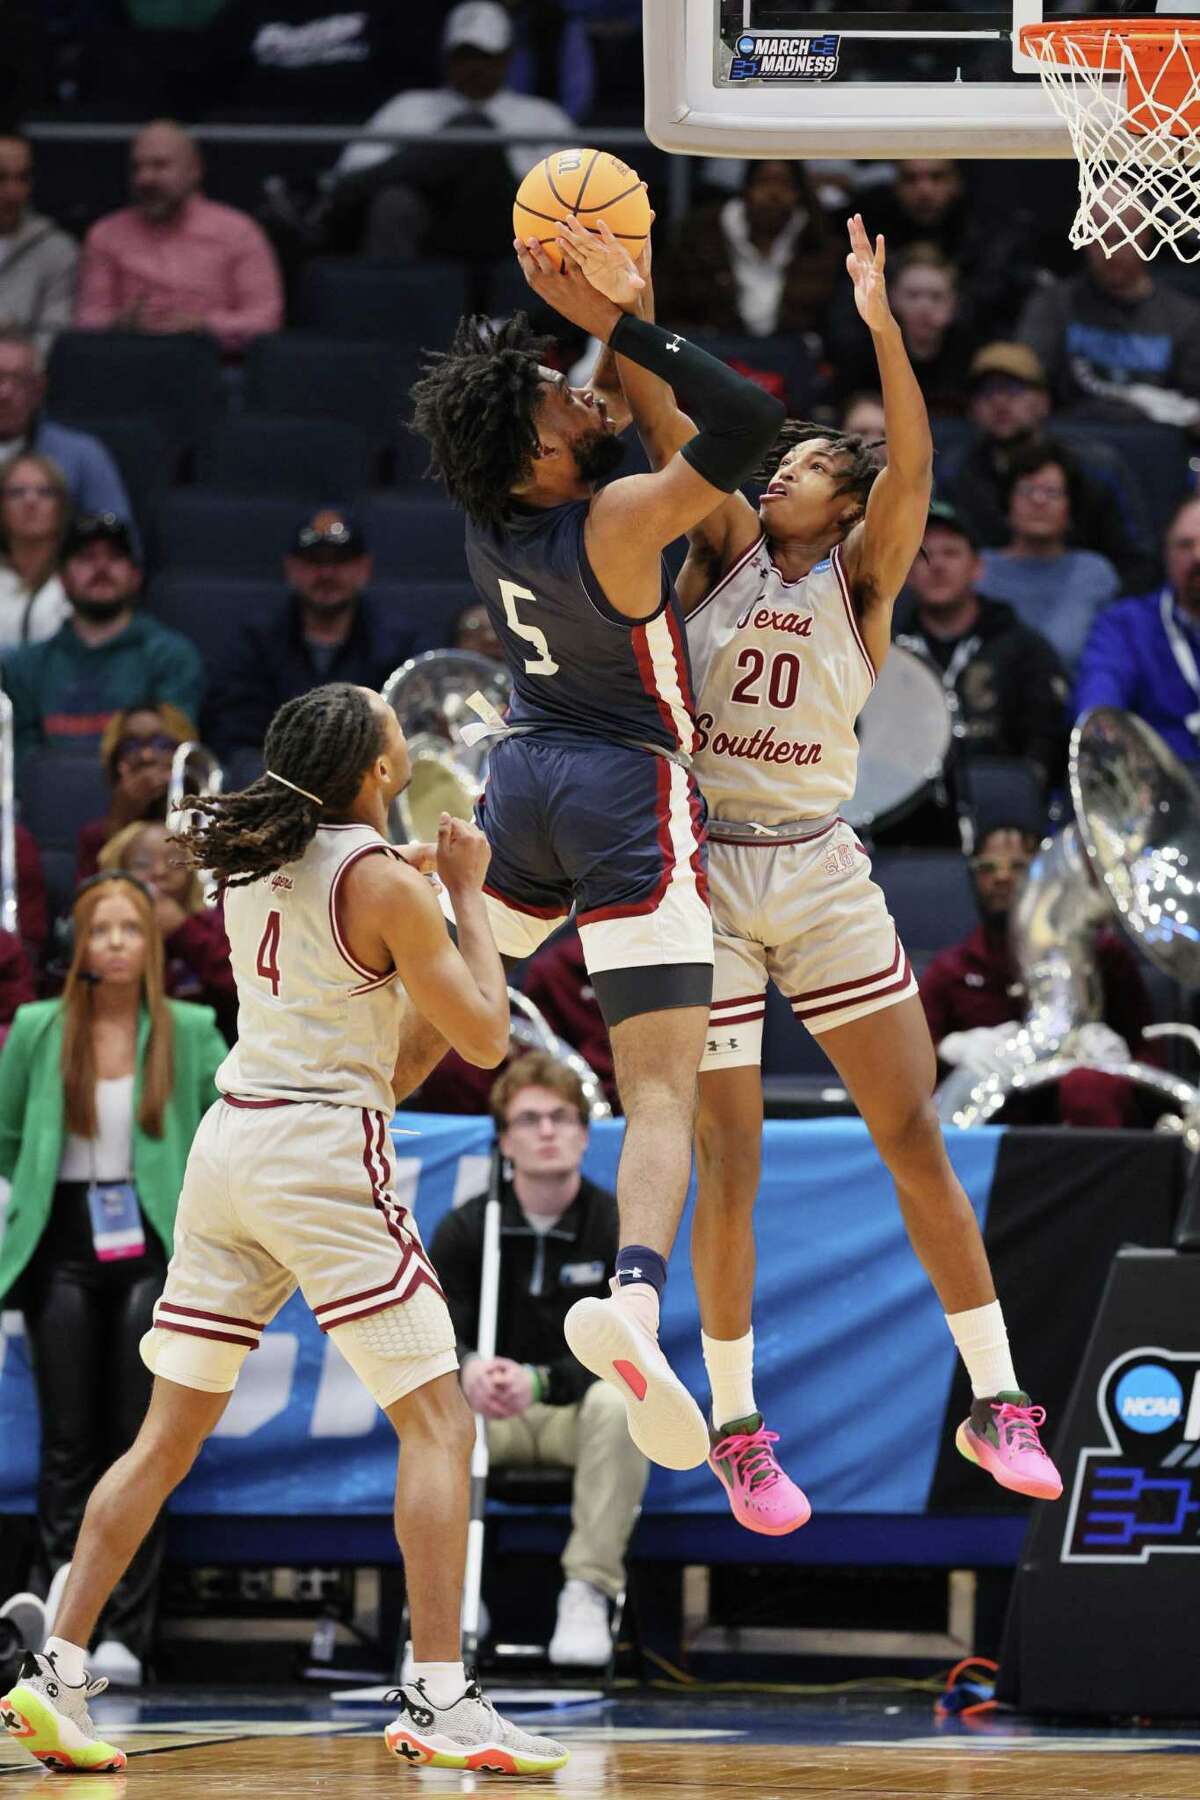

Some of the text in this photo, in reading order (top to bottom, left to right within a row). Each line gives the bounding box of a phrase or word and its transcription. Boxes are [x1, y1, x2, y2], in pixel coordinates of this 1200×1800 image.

[754, 39, 810, 55] MARCH
[760, 56, 835, 72] MADNESS
[498, 578, 560, 676] 5
[731, 648, 800, 708] 20
[697, 713, 822, 765] Southern
[263, 872, 294, 892] igers
[257, 911, 280, 996] 4
[1122, 1396, 1180, 1417] NCAA
